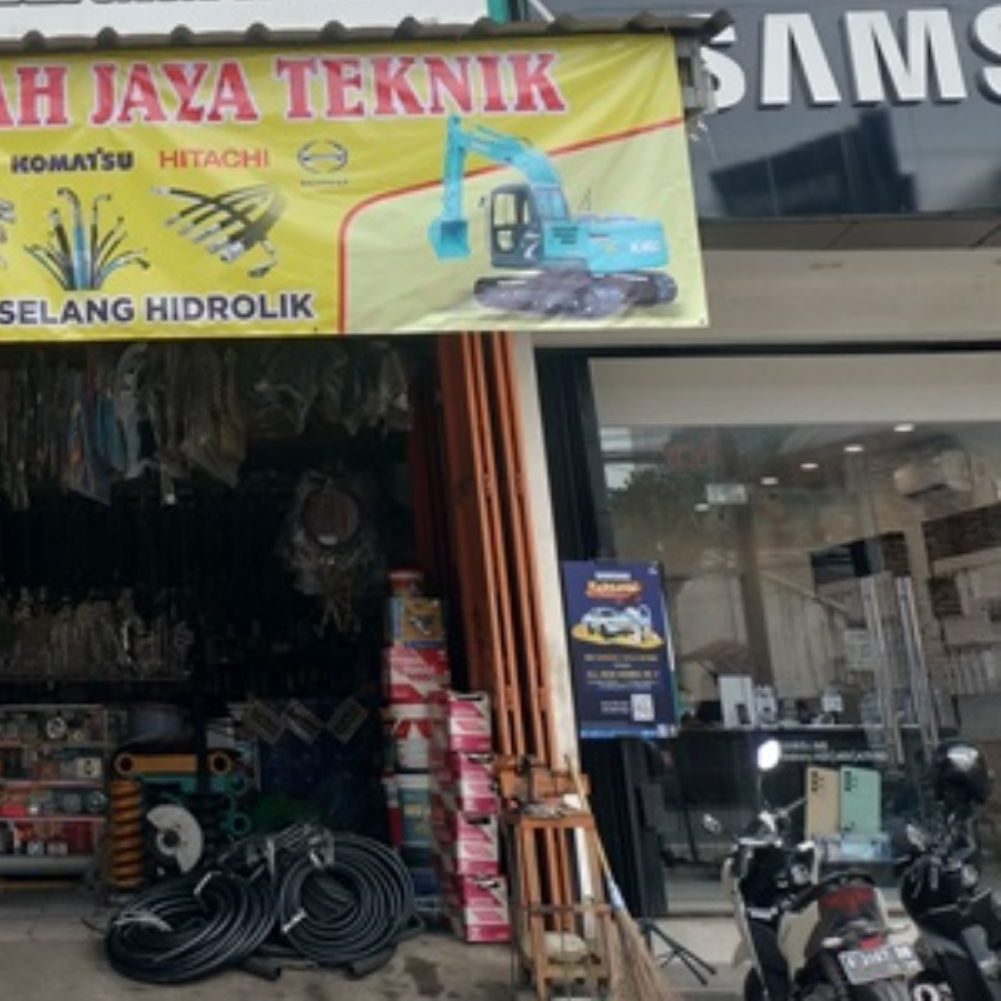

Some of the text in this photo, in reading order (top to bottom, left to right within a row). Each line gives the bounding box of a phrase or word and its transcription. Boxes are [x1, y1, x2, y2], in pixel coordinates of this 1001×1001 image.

[91, 60, 261, 126] JAYA
[275, 51, 567, 120] TEKNIK
[10, 148, 134, 175] KOMATSU
[158, 148, 271, 170] HITACHI
[145, 293, 313, 322] HIDROLIK
